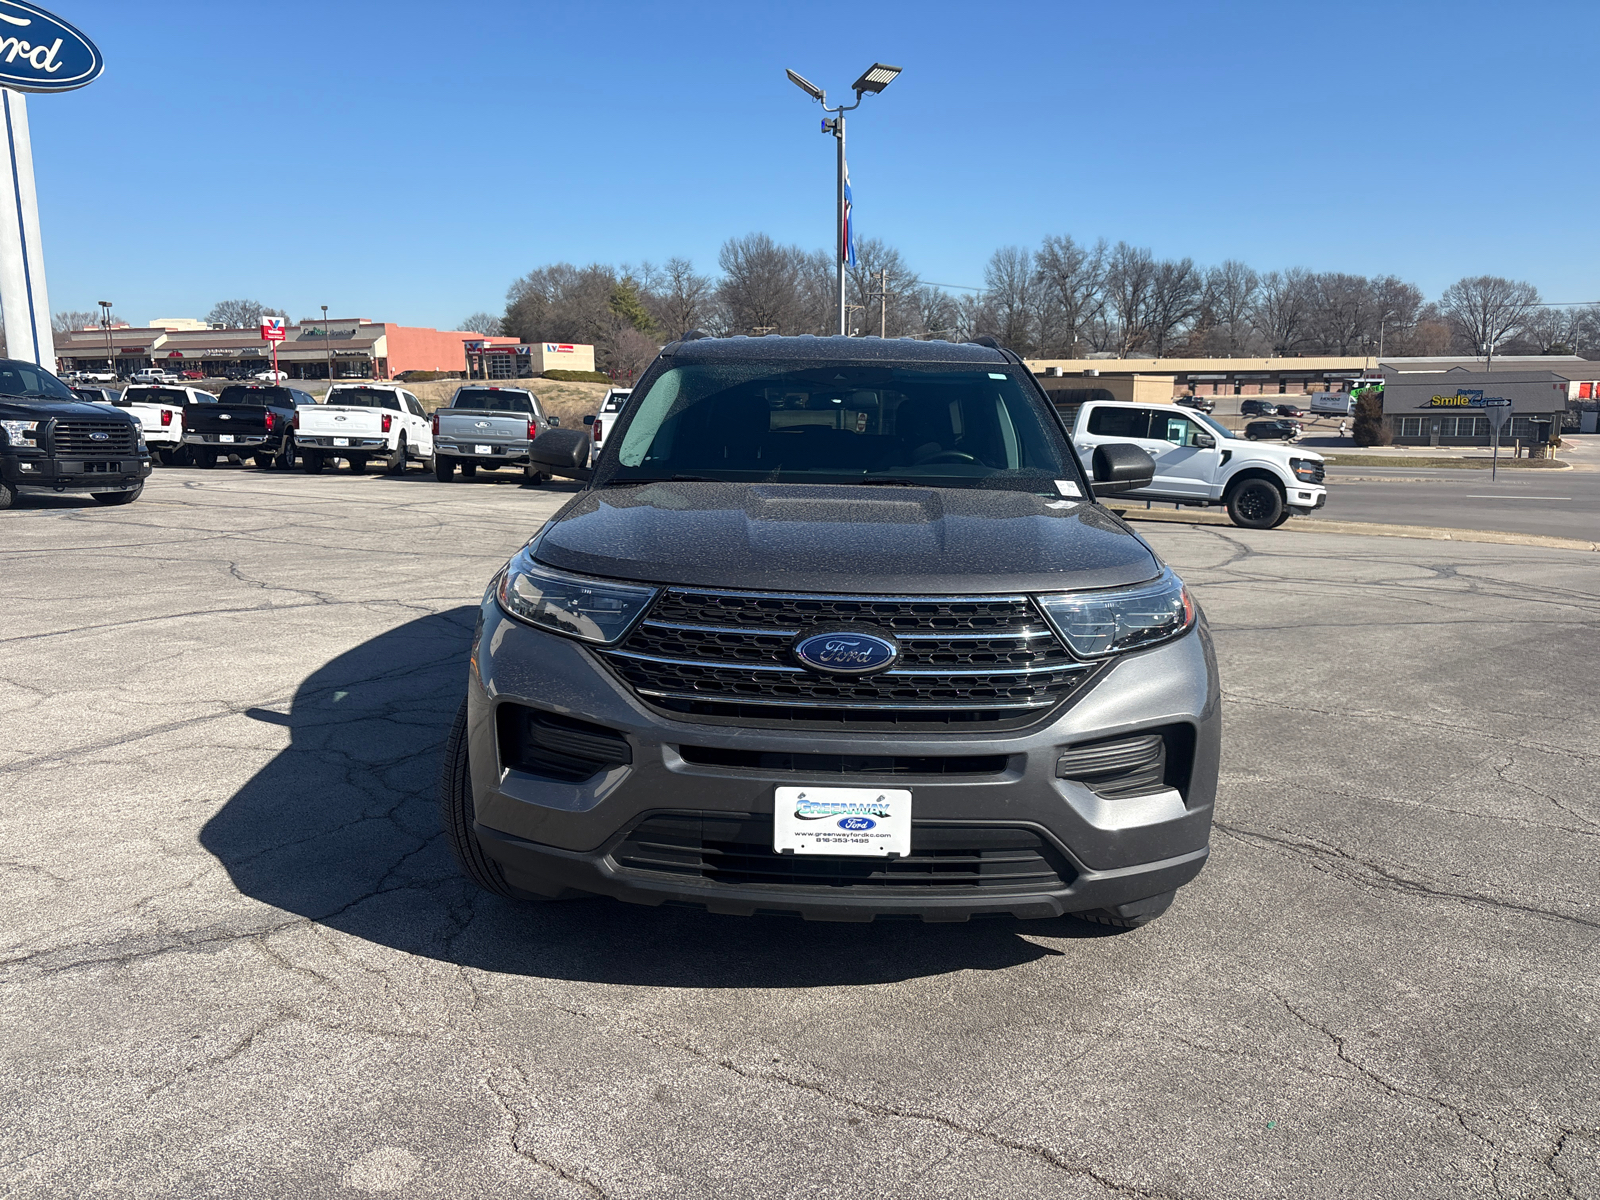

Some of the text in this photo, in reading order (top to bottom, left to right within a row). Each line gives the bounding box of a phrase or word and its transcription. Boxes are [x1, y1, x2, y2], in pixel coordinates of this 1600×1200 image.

[1431, 395, 1469, 406] Smile
[820, 640, 873, 663] Ford
[796, 800, 890, 815] GREENWAY
[845, 818, 868, 829] Ford
